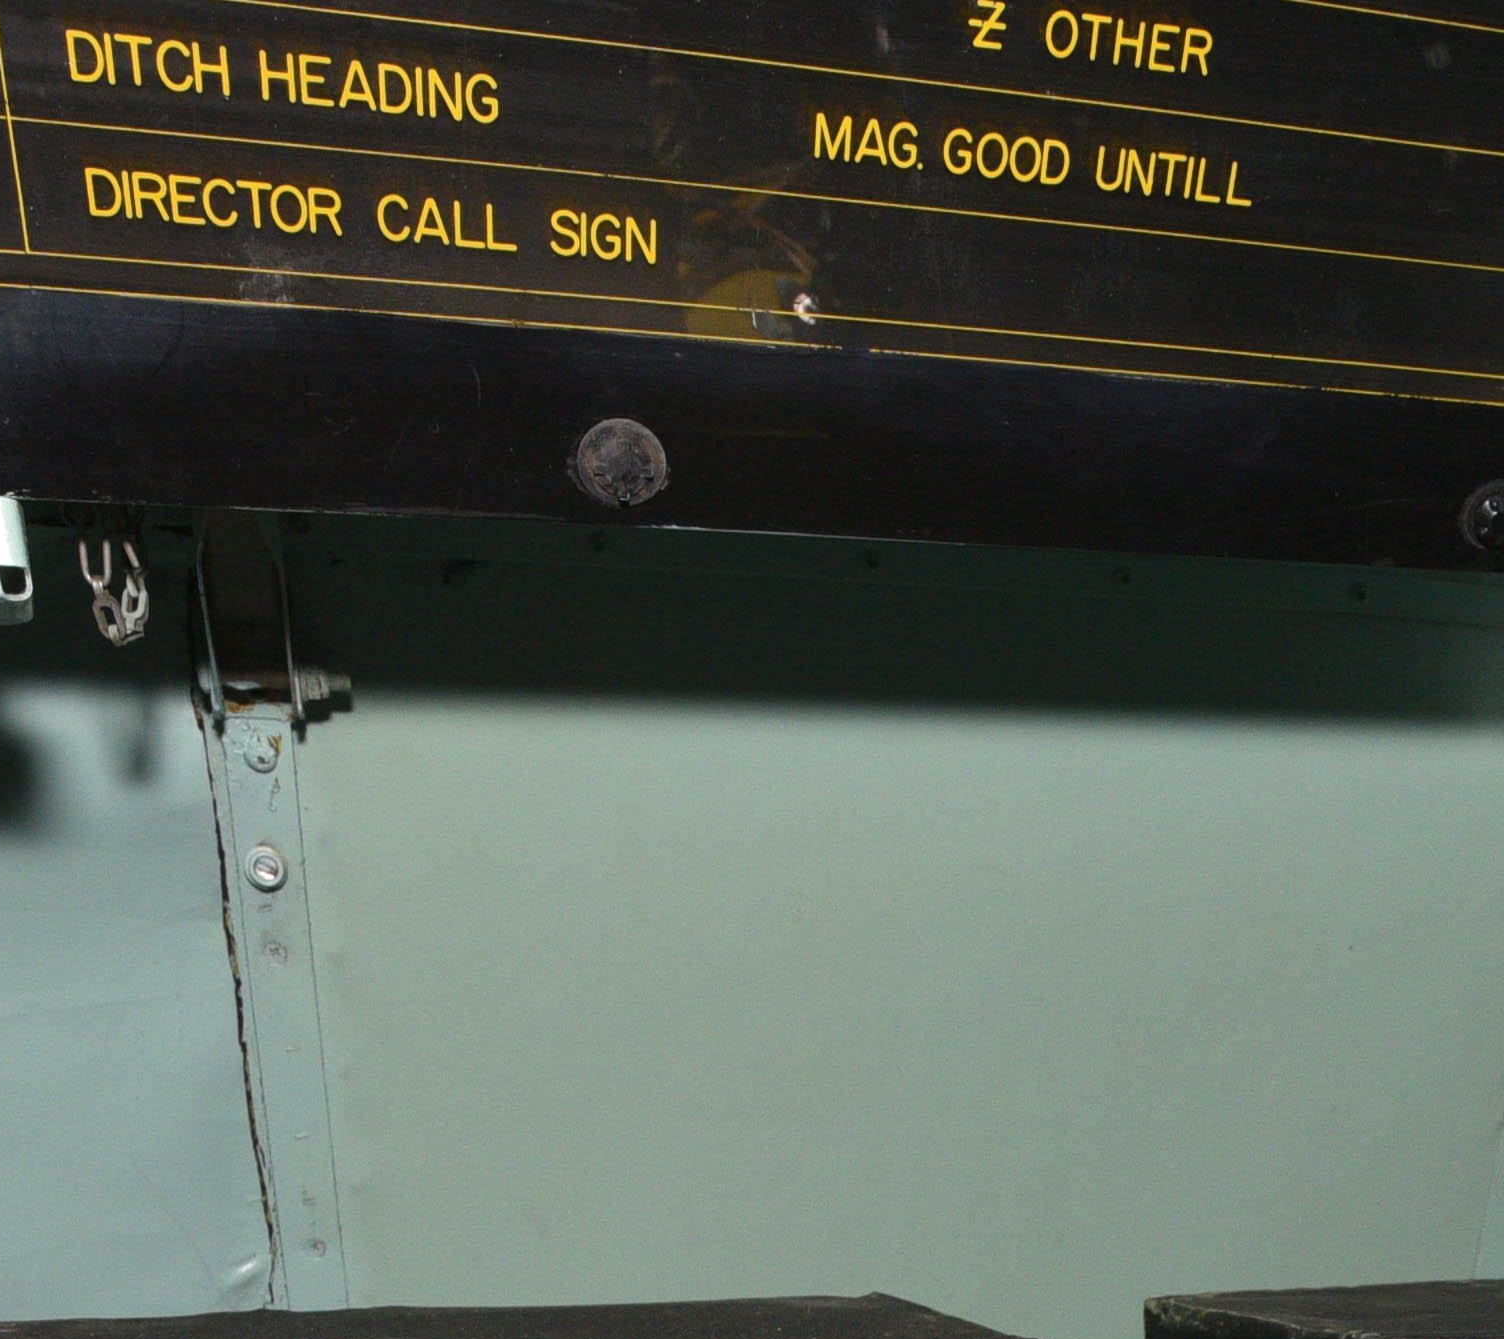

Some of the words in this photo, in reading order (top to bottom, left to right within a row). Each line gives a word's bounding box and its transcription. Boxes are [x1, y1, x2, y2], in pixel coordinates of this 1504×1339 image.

[65, 29, 229, 97] DITCH
[258, 50, 499, 124] HEADING
[1045, 9, 1213, 76] OTHER
[814, 112, 924, 171] MAG.
[943, 128, 1070, 186] GOOD
[1096, 145, 1252, 207] UNTILL
[84, 167, 343, 236] DIRECTOR
[377, 194, 517, 252] CALL
[550, 210, 657, 265] SIGN
